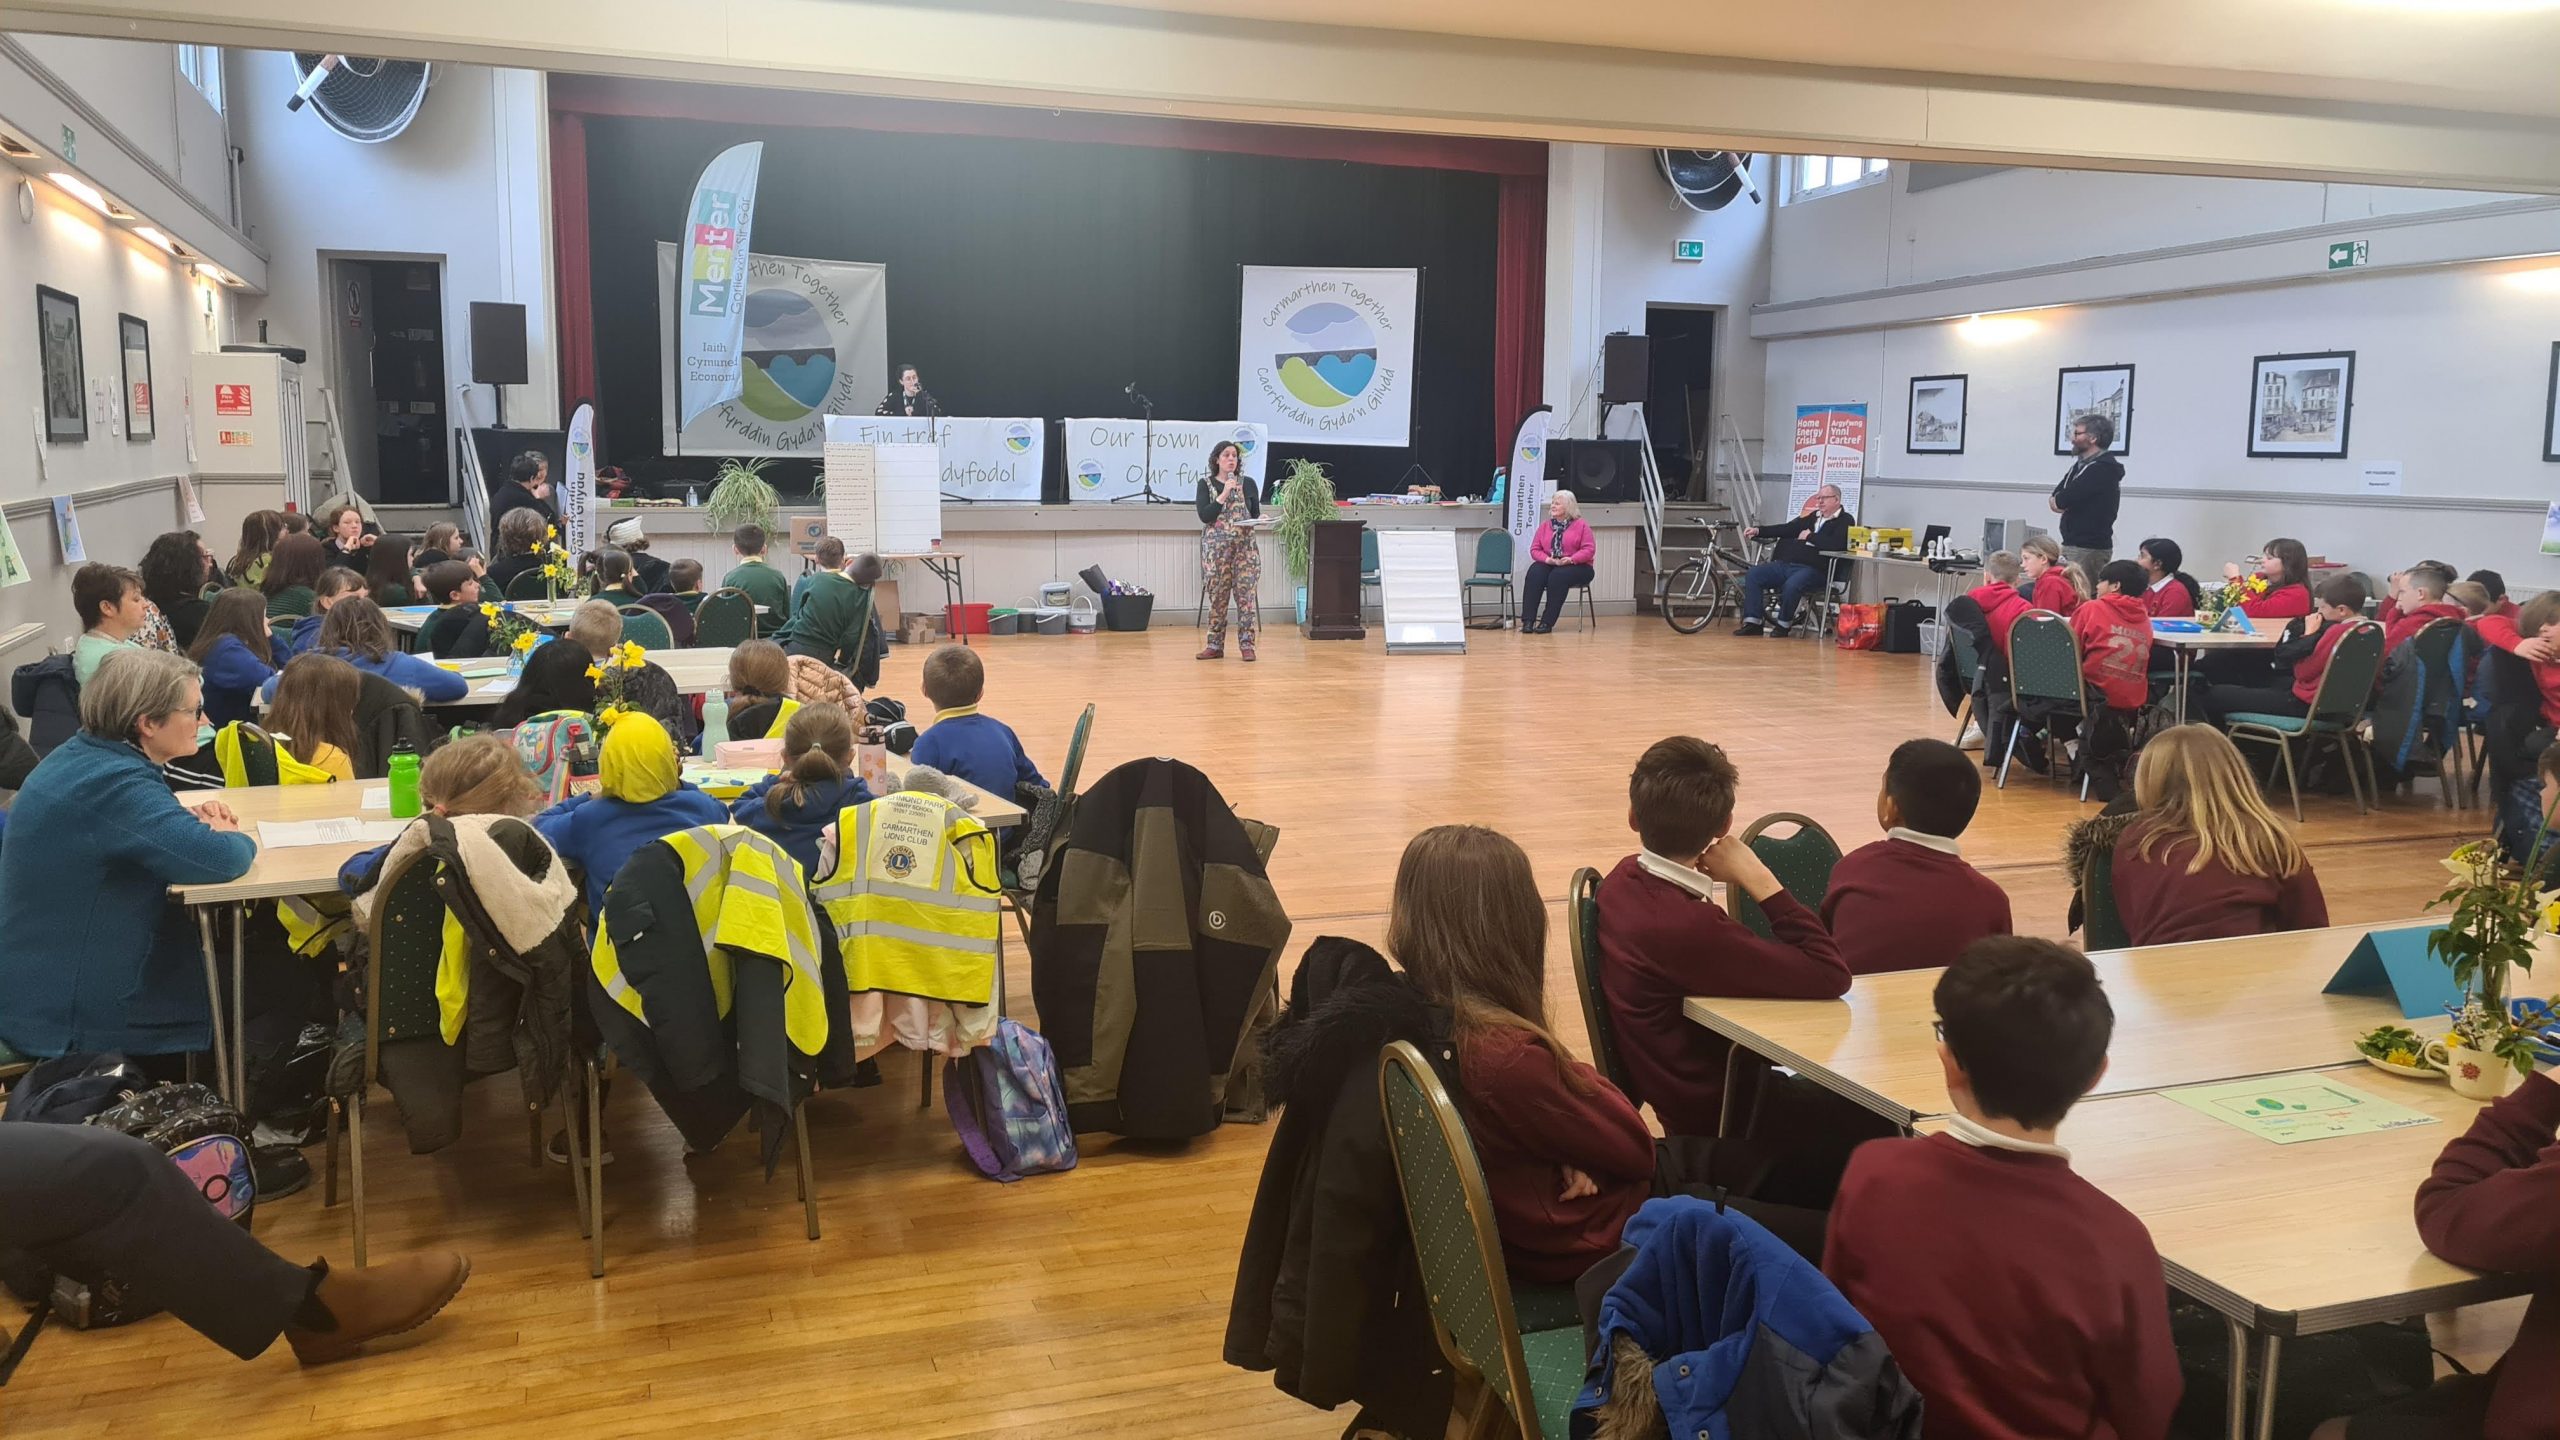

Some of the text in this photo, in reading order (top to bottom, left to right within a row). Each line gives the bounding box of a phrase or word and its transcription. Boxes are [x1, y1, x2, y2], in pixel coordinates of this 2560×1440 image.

[736, 230, 748, 244] Sir
[698, 192, 730, 313] Menter
[731, 249, 745, 315] Gorllewin
[791, 264, 849, 326] Together
[1262, 280, 1392, 331] Carmarthen Together
[702, 342, 727, 352] Iaith
[1257, 367, 1395, 431] Caerfyrddin Gyda'n Gilydd
[718, 401, 770, 447] fyrddin
[1796, 428, 1823, 438] Energy
[1797, 420, 1820, 428] Home
[1830, 427, 1849, 435] Ynni
[1090, 426, 1135, 448] Our
[1142, 430, 1200, 449] town
[1796, 436, 1817, 444] Crisis
[1829, 436, 1862, 445] Cartref
[1795, 452, 1818, 465] Help
[941, 461, 1016, 487] dyfodol
[1126, 464, 1168, 484] Our
[1176, 462, 1210, 487] fut
[1514, 474, 1526, 536] Carmarthen
[1526, 483, 1535, 529] Together
[576, 519, 584, 558] yda'n
[924, 799, 945, 809] PARK
[881, 822, 934, 838] CARMARTHEN
[884, 831, 928, 846] LIONS CLUB
[895, 855, 905, 868] L
